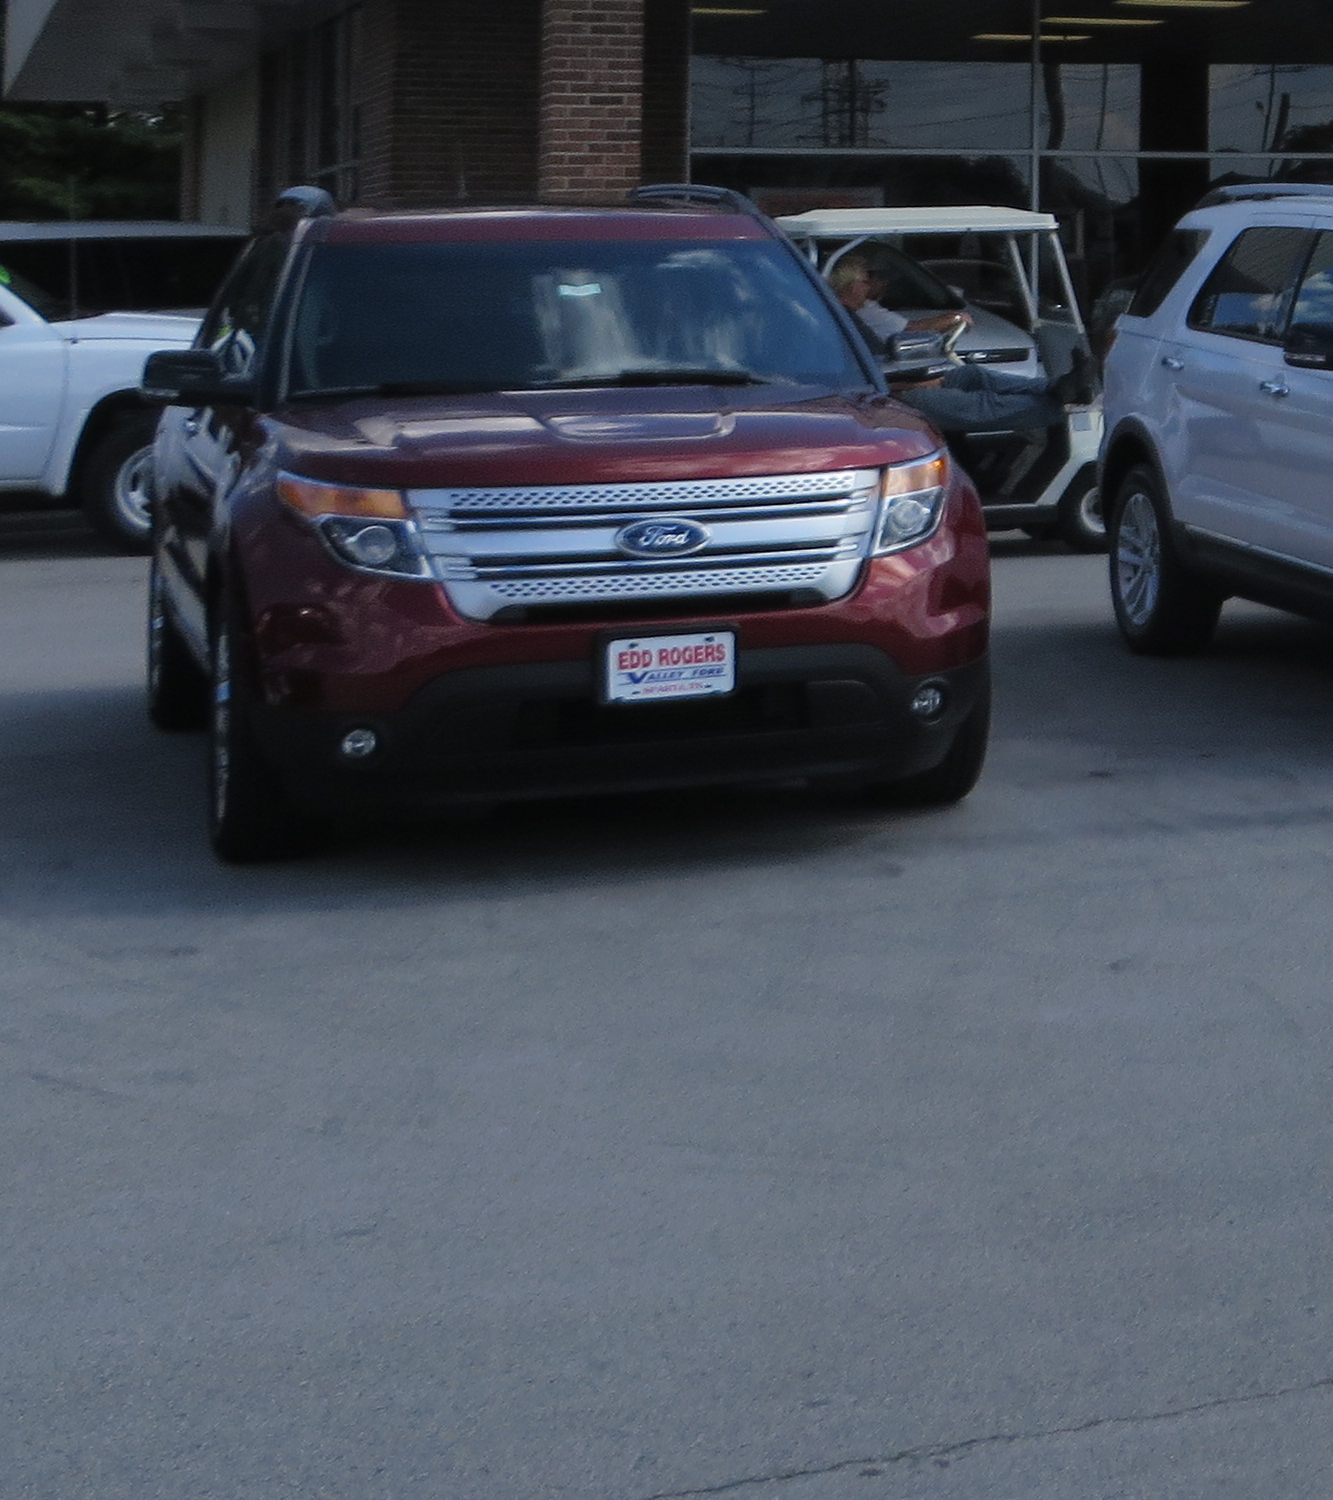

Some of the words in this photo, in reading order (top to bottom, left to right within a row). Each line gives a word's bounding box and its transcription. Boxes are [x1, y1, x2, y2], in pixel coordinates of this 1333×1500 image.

[638, 525, 690, 546] Ford
[618, 649, 653, 670] EDD
[658, 643, 726, 666] ROGERS
